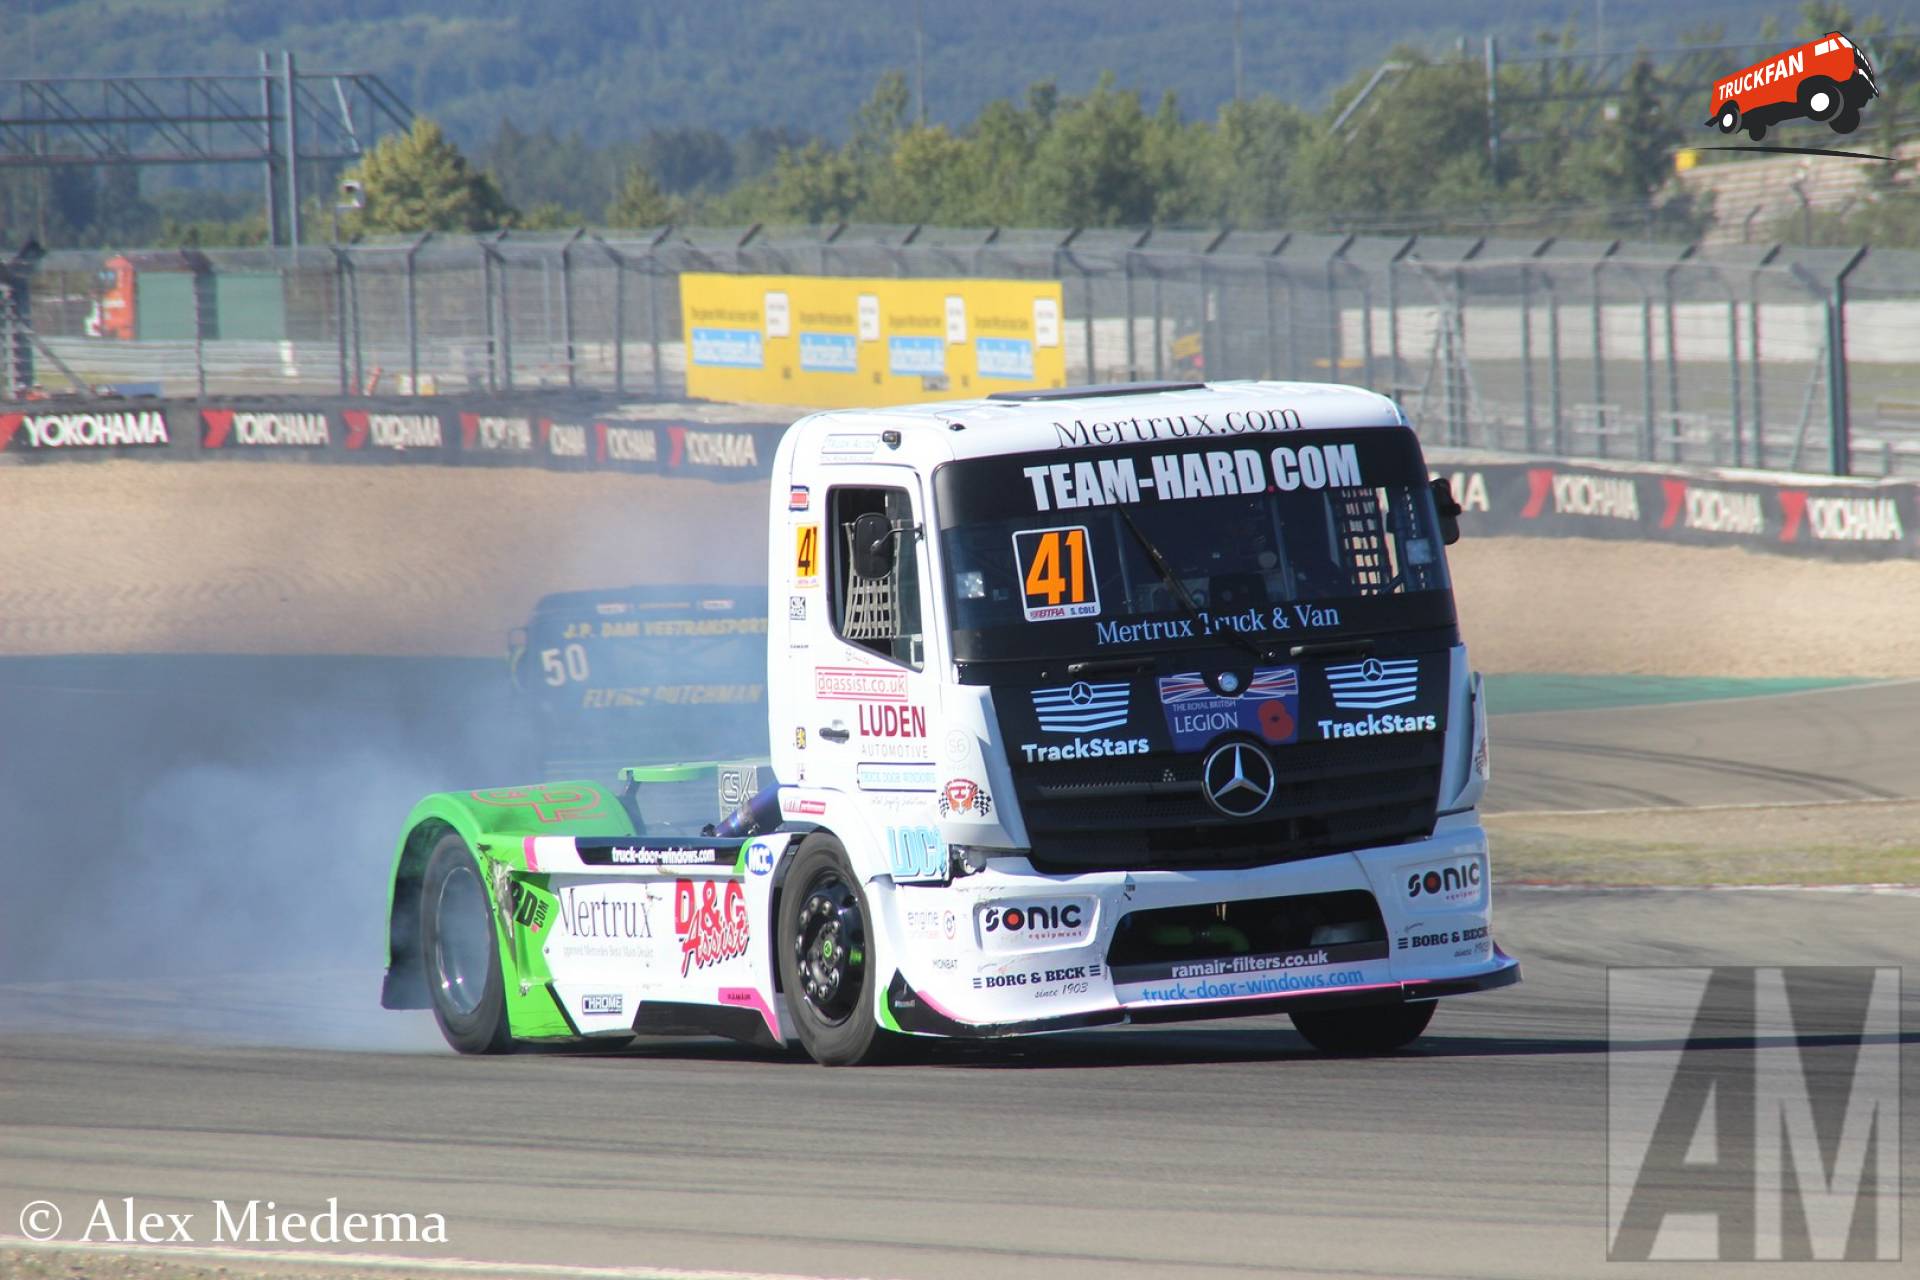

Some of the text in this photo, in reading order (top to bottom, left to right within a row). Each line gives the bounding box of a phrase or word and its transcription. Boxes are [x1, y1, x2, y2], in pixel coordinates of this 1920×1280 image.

[24, 412, 168, 447] YOKOHAMA
[233, 413, 329, 444] YOKOHAMA
[1052, 407, 1304, 449] Mertrux.com
[1024, 444, 1362, 511] TEAM-HARD.COM
[1806, 497, 1903, 540] YOKOHAMA
[797, 526, 817, 577] 41
[1026, 530, 1085, 605] 41
[1097, 618, 1194, 645] Mertrux
[1272, 607, 1291, 630] &
[1294, 604, 1341, 628] Van
[541, 644, 591, 687] 50
[859, 704, 927, 738] LUDEN
[1174, 711, 1239, 734] LEGION
[1318, 712, 1437, 740] TrackStars
[1021, 737, 1150, 763] TrackStars
[612, 847, 716, 864] truck-door-windows.com
[557, 887, 653, 938] Mertrux
[1411, 933, 1449, 948] BORG
[1451, 931, 1460, 944] &
[986, 966, 1087, 989] BORG & BECK
[1171, 950, 1329, 979] ramair-filters.co.uk
[1143, 968, 1365, 1003] truck-door-windows.com
